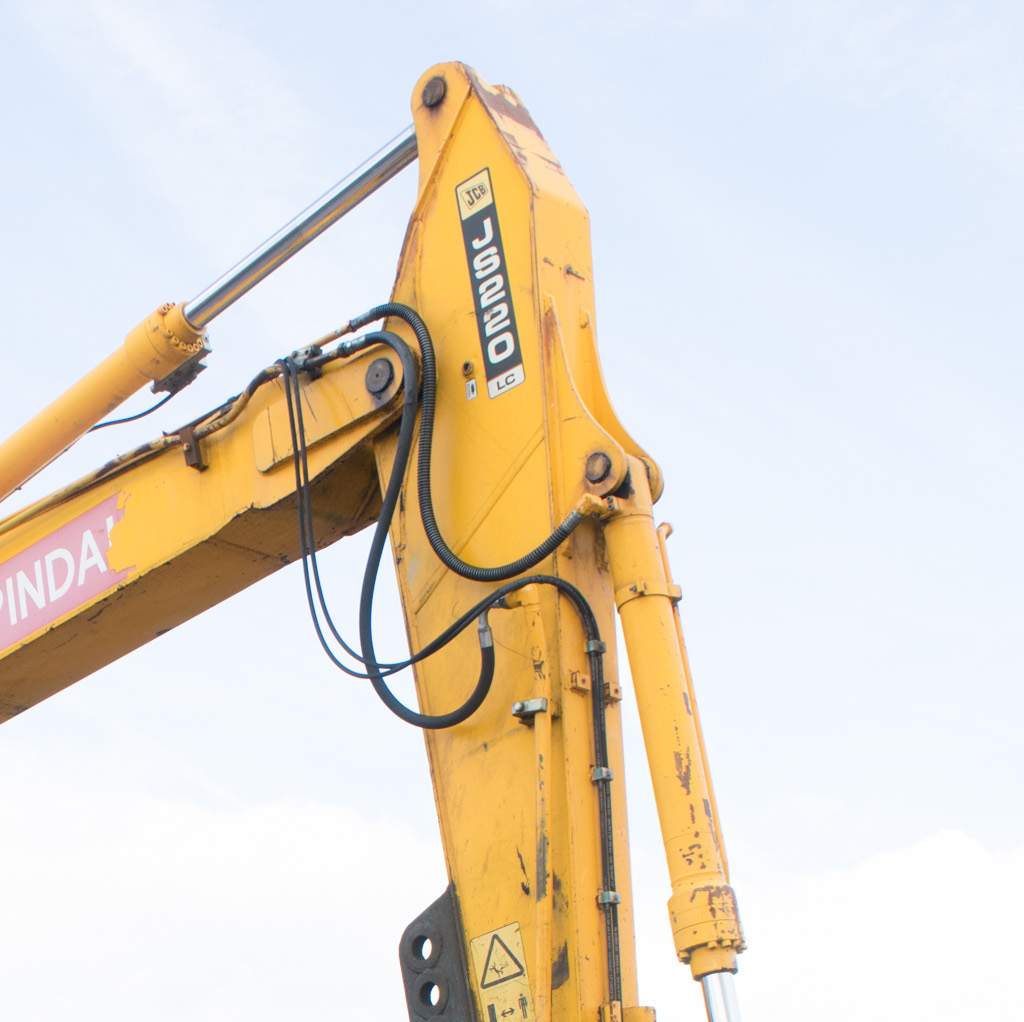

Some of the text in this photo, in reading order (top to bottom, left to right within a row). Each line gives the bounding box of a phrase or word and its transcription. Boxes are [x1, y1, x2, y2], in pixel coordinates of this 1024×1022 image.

[465, 184, 487, 207] JCB
[472, 216, 515, 365] JS220
[496, 373, 516, 391] LC
